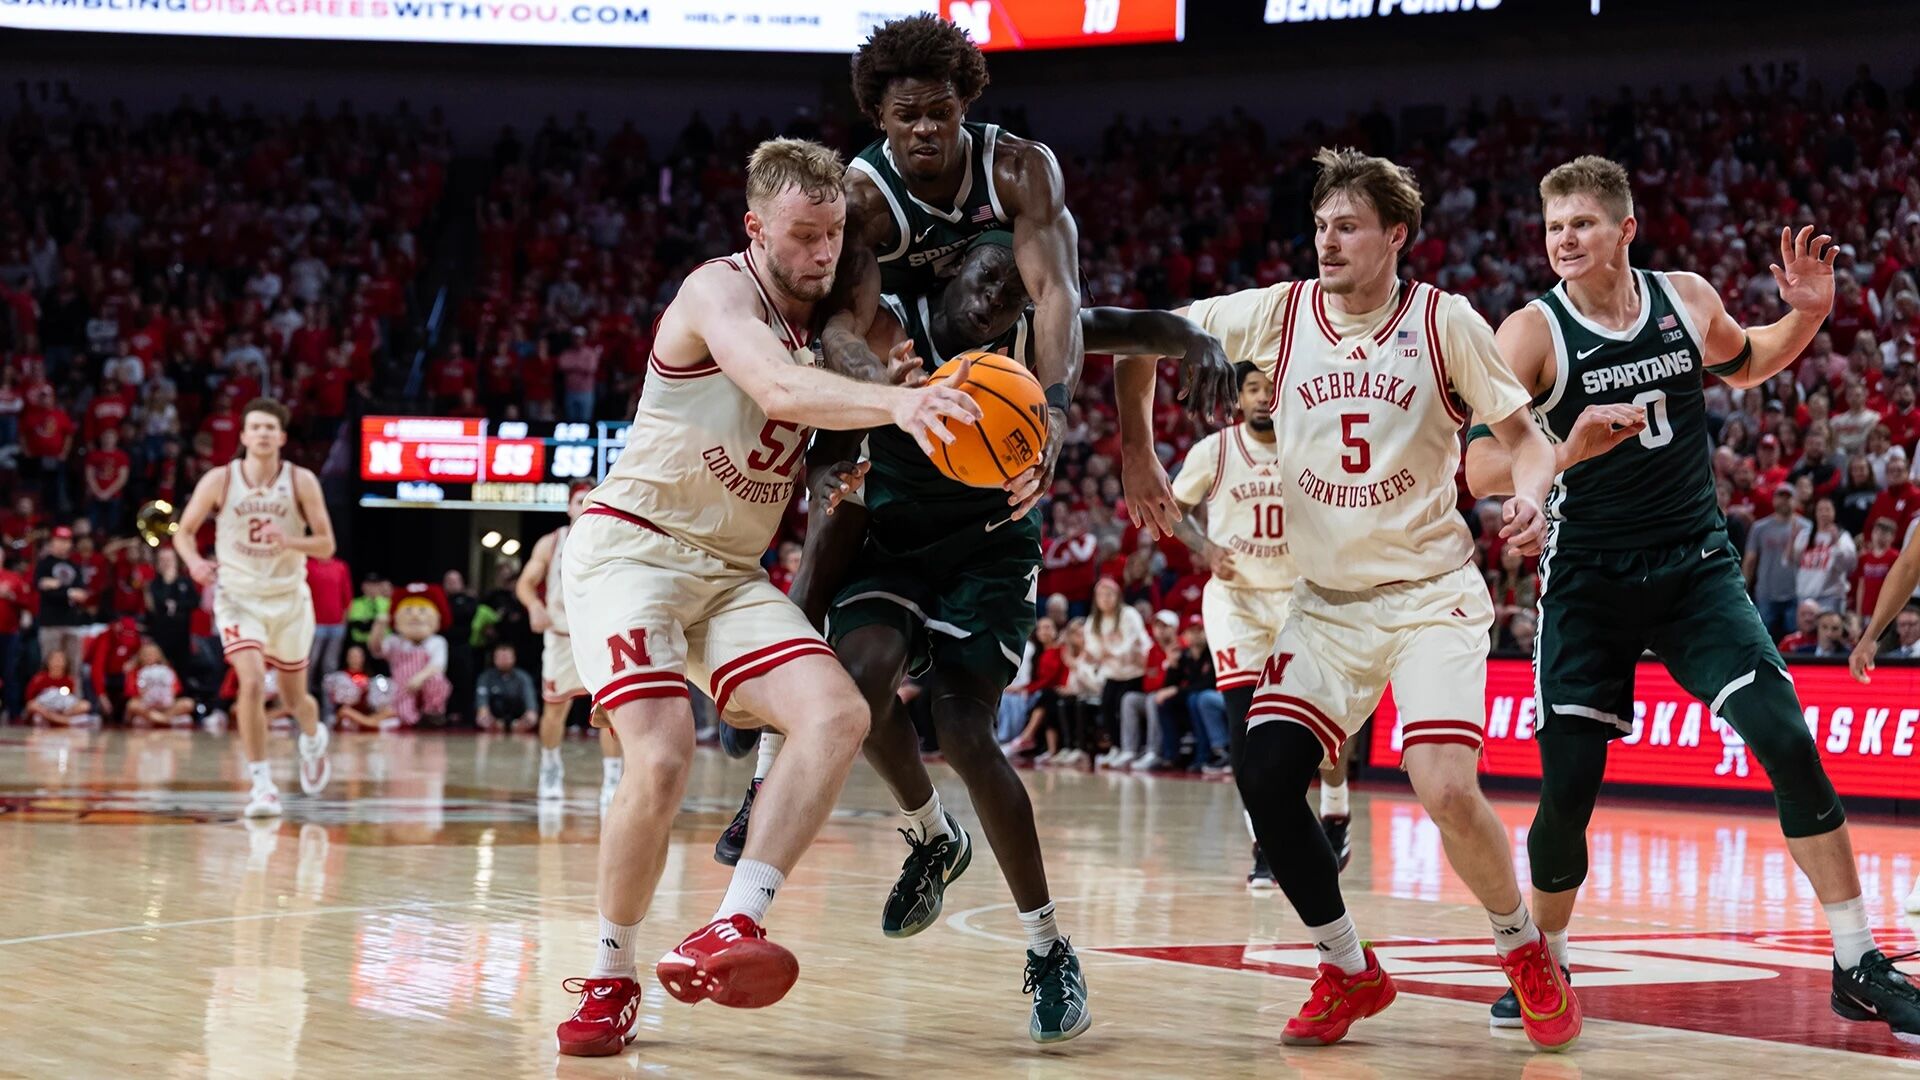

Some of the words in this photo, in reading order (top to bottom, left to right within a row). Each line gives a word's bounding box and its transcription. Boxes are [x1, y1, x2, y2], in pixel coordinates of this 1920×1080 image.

[0, 0, 649, 23] BLINGDISAGREESWITHYOU.COM
[1582, 349, 1693, 395] SPARTANS
[1297, 372, 1417, 411] NEBRASKA
[1632, 389, 1673, 449] 0
[369, 441, 402, 474] N
[492, 444, 534, 476] 55
[552, 445, 594, 477] 55
[1009, 428, 1033, 462] PRO
[1341, 414, 1371, 474] 5
[702, 445, 794, 503] CORNHUSKE
[1298, 468, 1416, 508] CORNHUSKERS
[1253, 504, 1283, 539] 10
[607, 627, 652, 674] N
[1216, 648, 1238, 672] N
[1256, 653, 1295, 690] N
